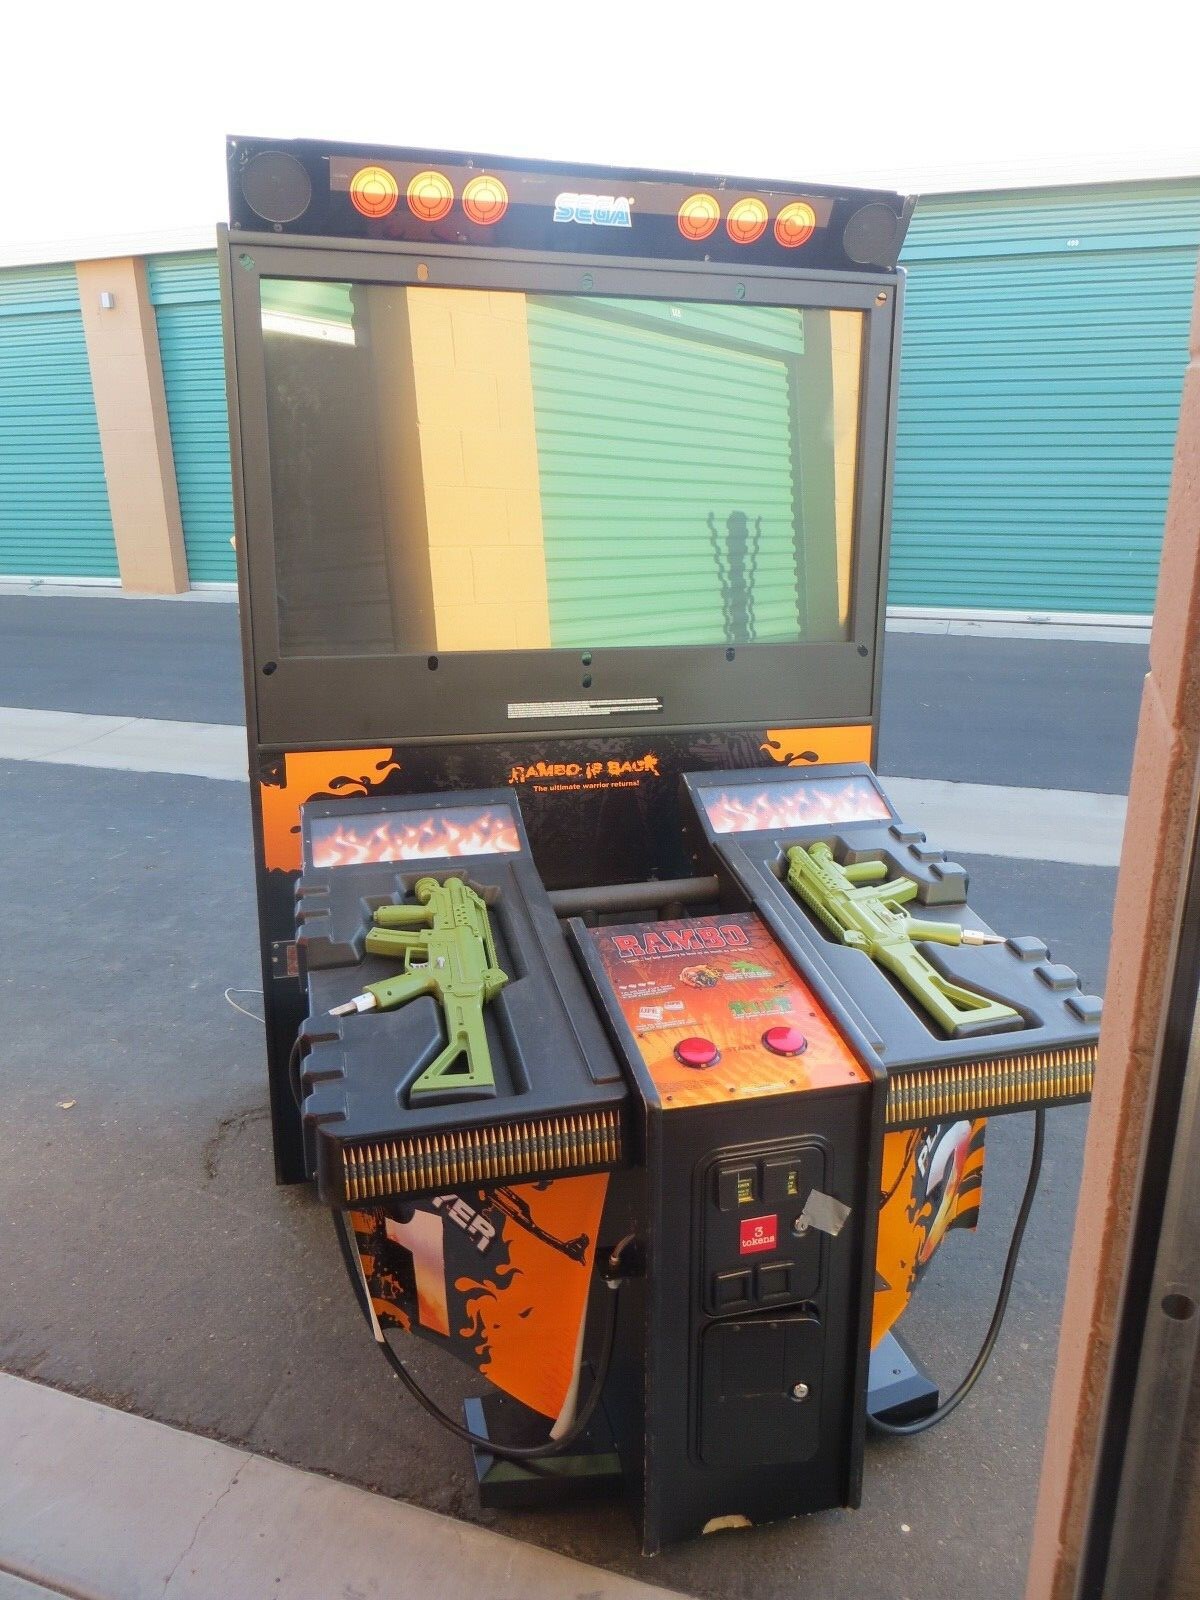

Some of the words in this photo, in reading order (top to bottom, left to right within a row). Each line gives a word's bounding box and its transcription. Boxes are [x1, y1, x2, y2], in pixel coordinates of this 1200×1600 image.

[553, 192, 632, 228] SEGA
[508, 761, 582, 785] RAMBO
[607, 752, 660, 777] BACK
[549, 783, 581, 791] ultimate
[582, 782, 610, 790] warrior
[611, 780, 640, 788] returns!
[612, 924, 750, 959] RAMBO
[742, 1235, 776, 1248] tokens
[754, 1226, 764, 1238] 3
